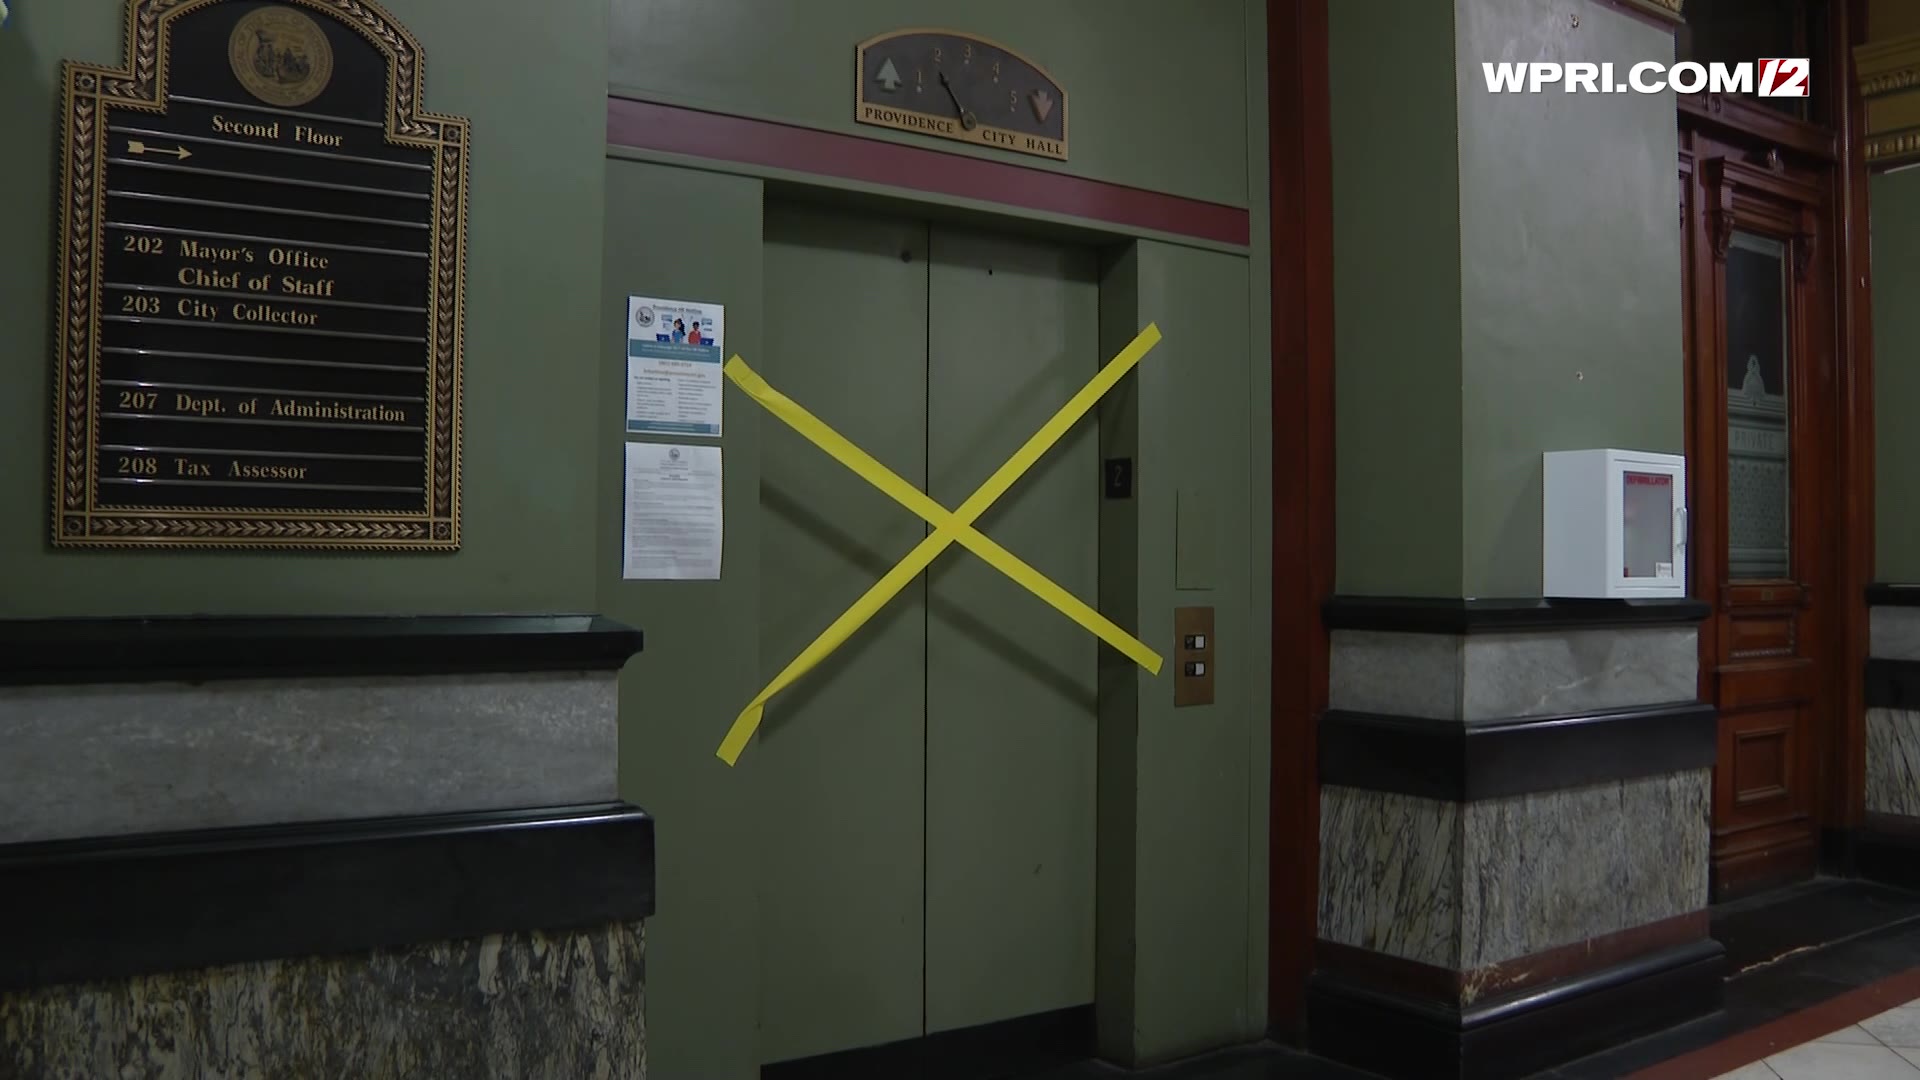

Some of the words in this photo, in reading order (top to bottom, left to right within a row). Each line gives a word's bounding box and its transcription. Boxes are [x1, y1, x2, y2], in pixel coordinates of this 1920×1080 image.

[934, 48, 942, 62] 2
[964, 45, 972, 59] 3
[1010, 91, 1018, 104] 5
[212, 114, 279, 139] Second
[295, 126, 343, 148] Floor
[865, 107, 954, 133] PROVIDENCE
[982, 129, 1017, 145] CITY
[1026, 138, 1063, 154] HALL
[123, 235, 163, 255] 202
[180, 239, 254, 264] Mayor's
[268, 248, 329, 269] Office
[178, 267, 240, 290] Chief
[248, 273, 270, 292] of
[282, 276, 335, 296] Staff
[122, 296, 160, 314] 203
[177, 299, 218, 321] City
[232, 303, 318, 326] Collector
[119, 391, 158, 410] 207
[176, 394, 226, 415] Dept.
[238, 398, 258, 415] of
[270, 399, 405, 422] Administration
[1735, 431, 1775, 450] PRIVATE
[118, 457, 158, 475] 208
[174, 458, 211, 476] Tax
[228, 460, 307, 480] Assessor
[1113, 465, 1122, 487] 2
